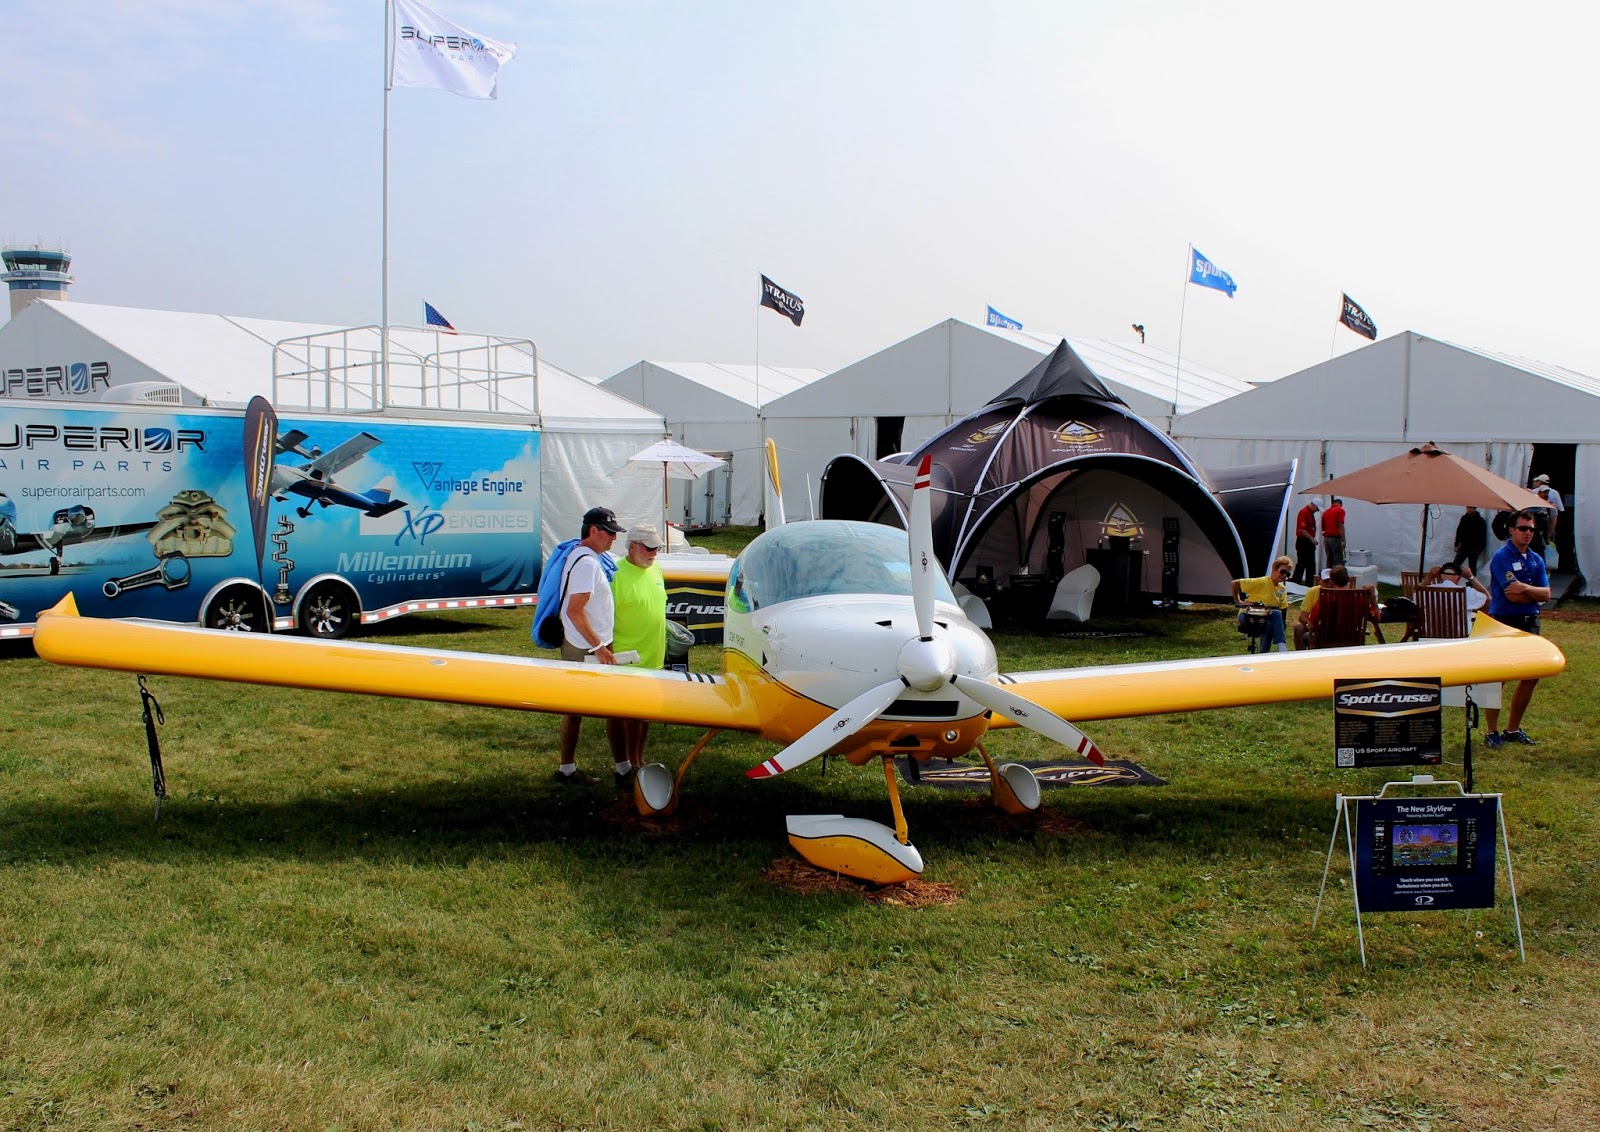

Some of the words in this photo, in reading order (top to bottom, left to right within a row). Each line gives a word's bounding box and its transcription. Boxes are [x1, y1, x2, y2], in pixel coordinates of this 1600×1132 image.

[764, 283, 803, 312] STRATUS
[0, 361, 111, 397] PERIOR
[73, 460, 173, 472] PARTS
[22, 485, 146, 500] superiorairparts.com
[482, 478, 523, 495] Engine
[394, 505, 445, 547] XP
[449, 514, 529, 529] ENGINES
[337, 551, 472, 573] Millennium
[368, 571, 440, 585] Cylinders
[1338, 693, 1438, 707] SportCruiser
[1396, 805, 1409, 813] The
[1410, 805, 1425, 813] New
[1426, 804, 1453, 814] SkyView
